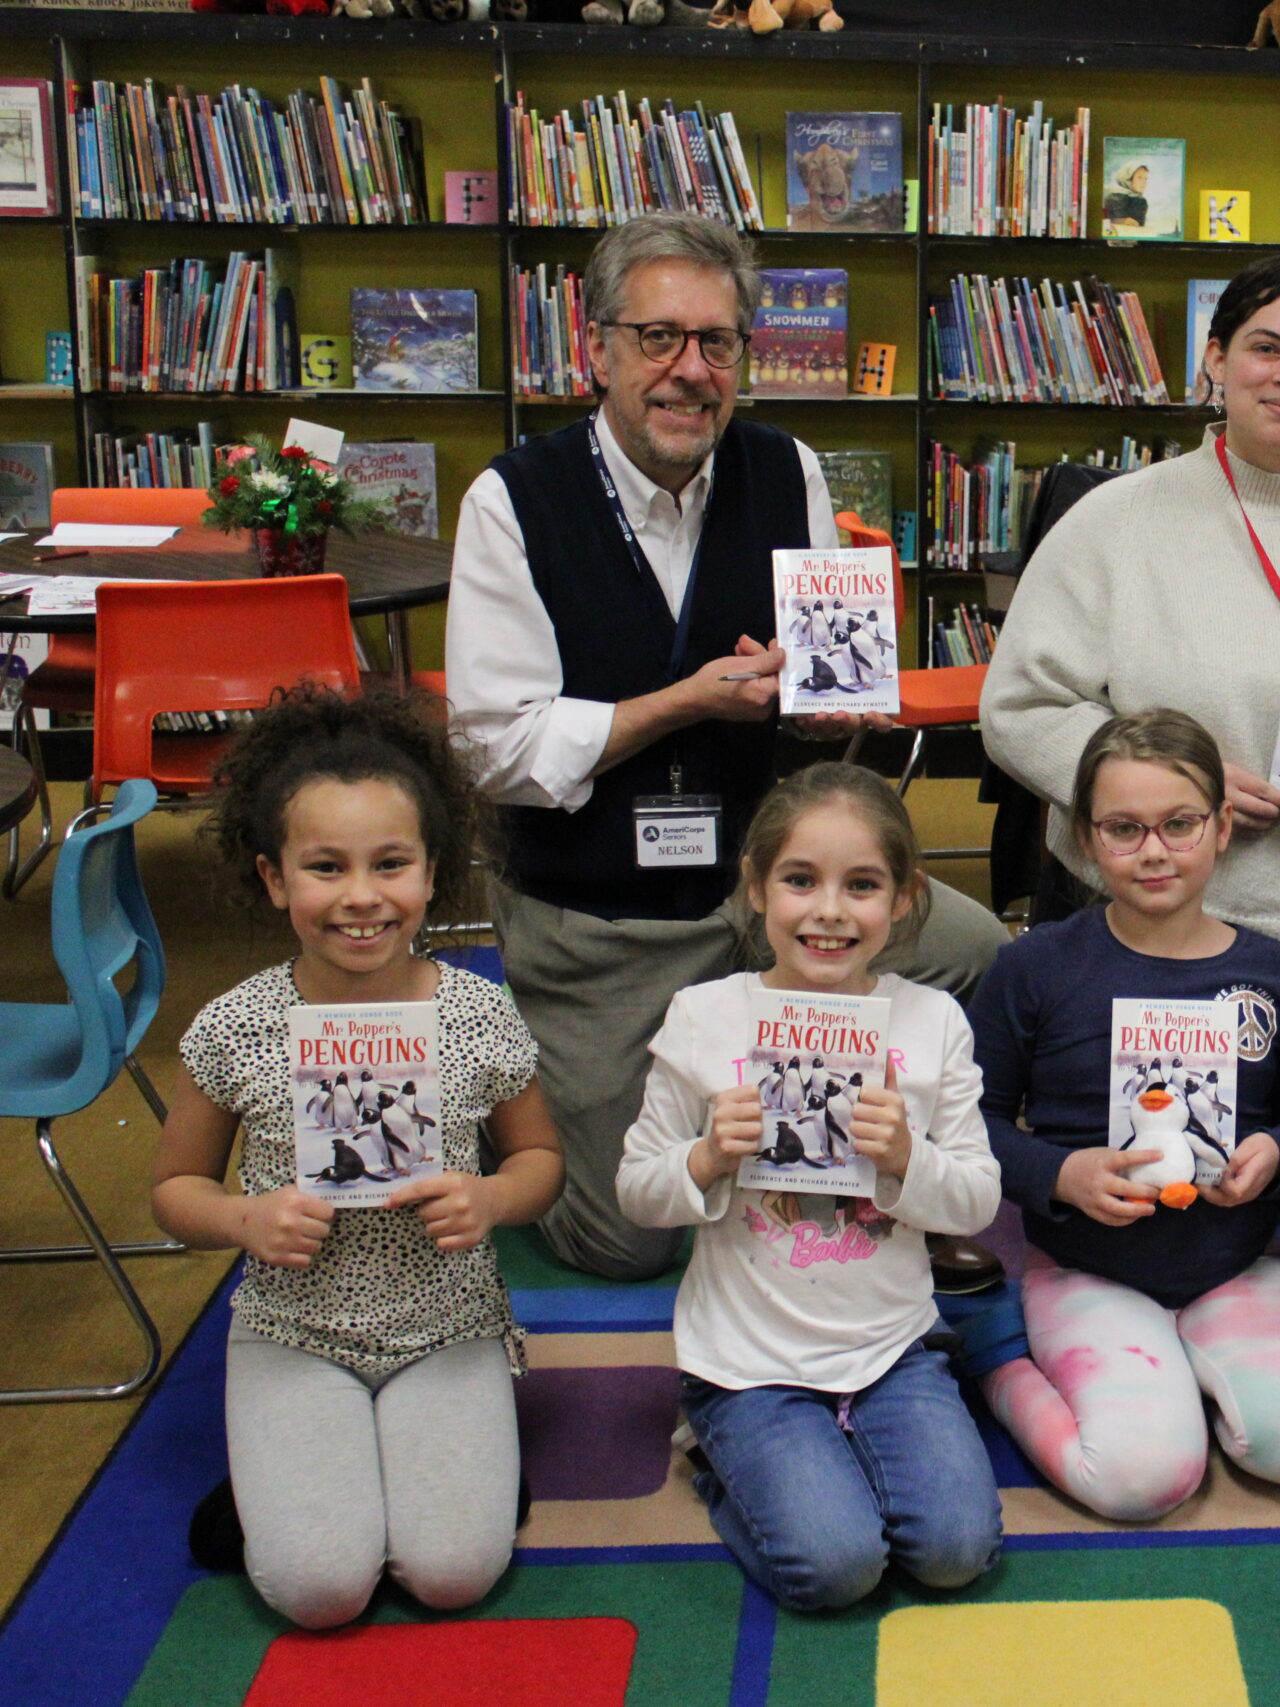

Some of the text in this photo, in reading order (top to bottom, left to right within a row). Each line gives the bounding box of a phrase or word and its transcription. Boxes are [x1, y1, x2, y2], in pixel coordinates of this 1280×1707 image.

[462, 178, 488, 221] F
[1209, 196, 1241, 239] K
[765, 314, 830, 327] SNOWMEN
[304, 339, 341, 384] G
[858, 346, 887, 391] H
[360, 452, 407, 470] Coyote
[344, 465, 418, 484] Christmas
[824, 559, 866, 575] Popper's
[783, 573, 887, 598] PENGUINS
[663, 826, 705, 834] AmeriCorps
[658, 845, 703, 856] NELSON
[807, 1007, 857, 1028] Popper's
[1165, 1012, 1210, 1029] Popper's
[348, 1020, 401, 1039] Popper's
[757, 1020, 880, 1056] PENGUINS
[1120, 1026, 1231, 1055] PENGUINS
[298, 1037, 427, 1067] PENGUINS
[790, 1220, 879, 1269] Barbie
